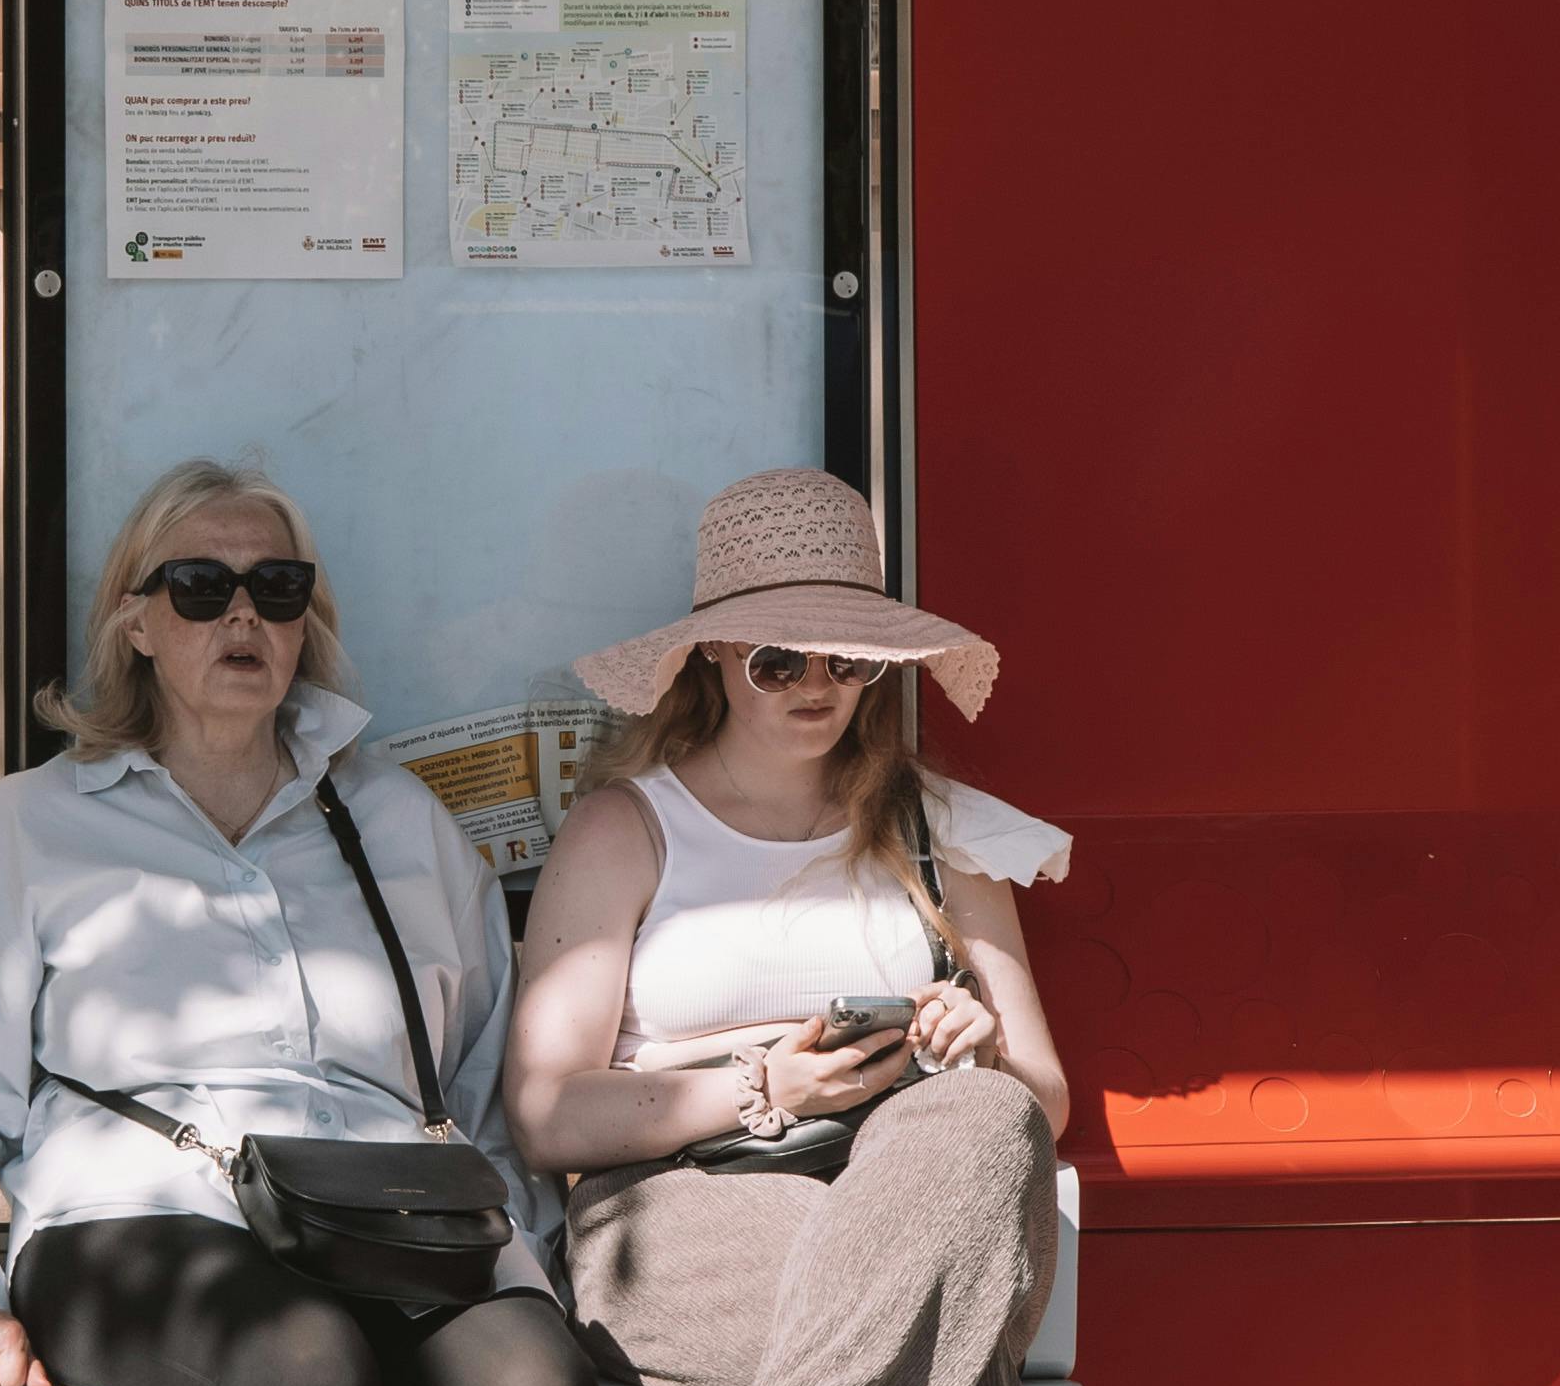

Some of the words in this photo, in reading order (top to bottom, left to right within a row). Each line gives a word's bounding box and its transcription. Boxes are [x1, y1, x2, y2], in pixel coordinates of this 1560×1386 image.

[389, 735, 427, 751] Programa
[429, 726, 465, 741] d'ajudes
[474, 713, 515, 730] municipis
[547, 707, 597, 717] implantació
